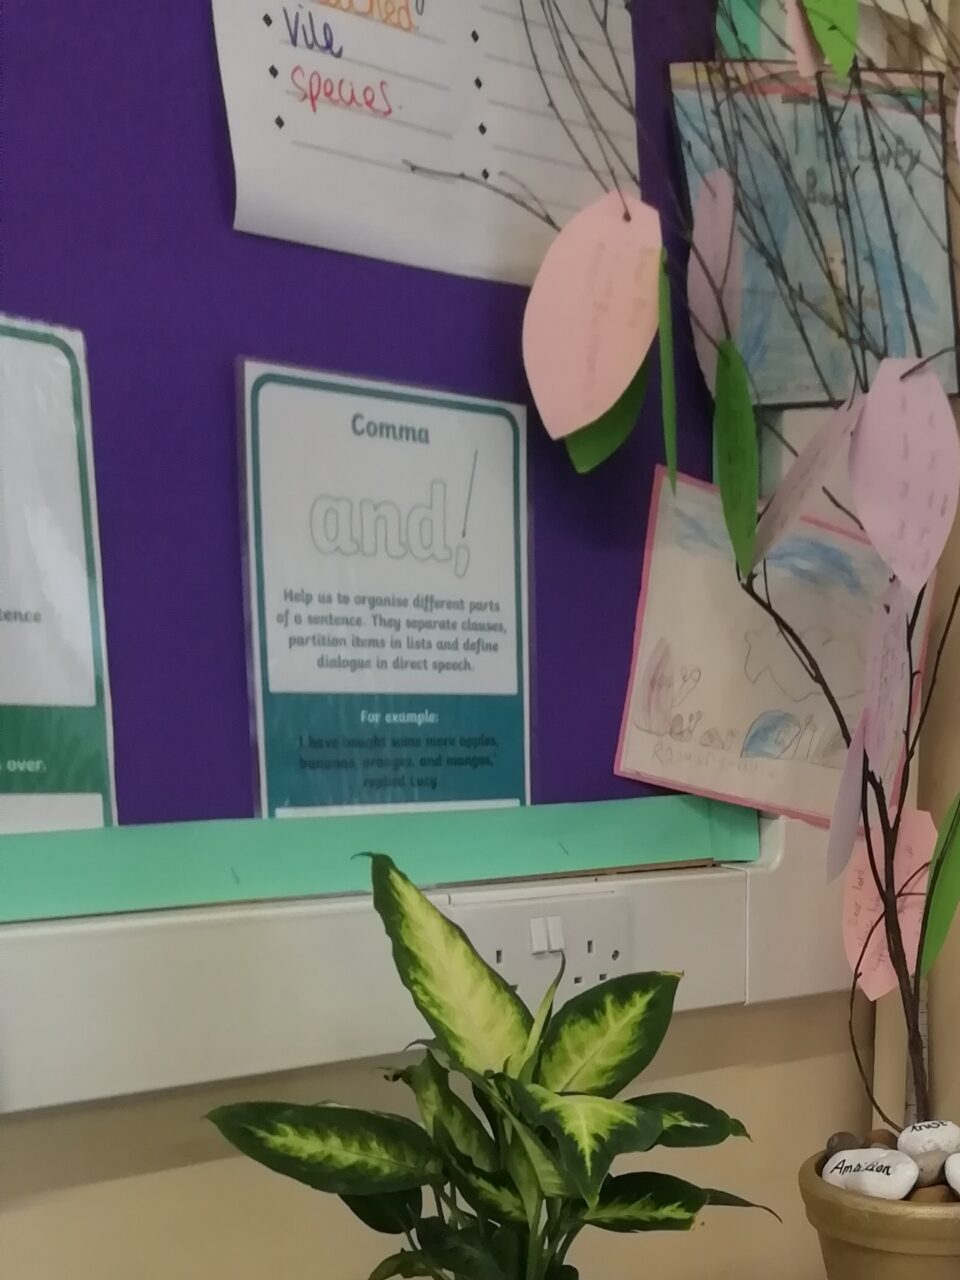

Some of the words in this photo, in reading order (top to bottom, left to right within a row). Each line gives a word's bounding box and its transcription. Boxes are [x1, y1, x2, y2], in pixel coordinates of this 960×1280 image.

[351, 412, 430, 445] Comma
[283, 588, 313, 606] Help
[318, 592, 332, 604] us
[337, 592, 350, 605] to
[354, 593, 408, 610] organise
[413, 593, 464, 613] different
[469, 600, 500, 614] parts
[276, 608, 289, 628] of
[294, 614, 302, 625] a
[371, 613, 401, 632] They
[406, 618, 458, 632] separate
[288, 633, 346, 650] partition
[351, 634, 386, 648] items
[390, 635, 402, 649] in
[406, 635, 432, 650] lists
[436, 637, 459, 651] and
[462, 637, 499, 655] define
[317, 654, 371, 673] dialogue
[376, 655, 388, 669] in
[392, 656, 427, 671] direct
[360, 709, 381, 723] For
